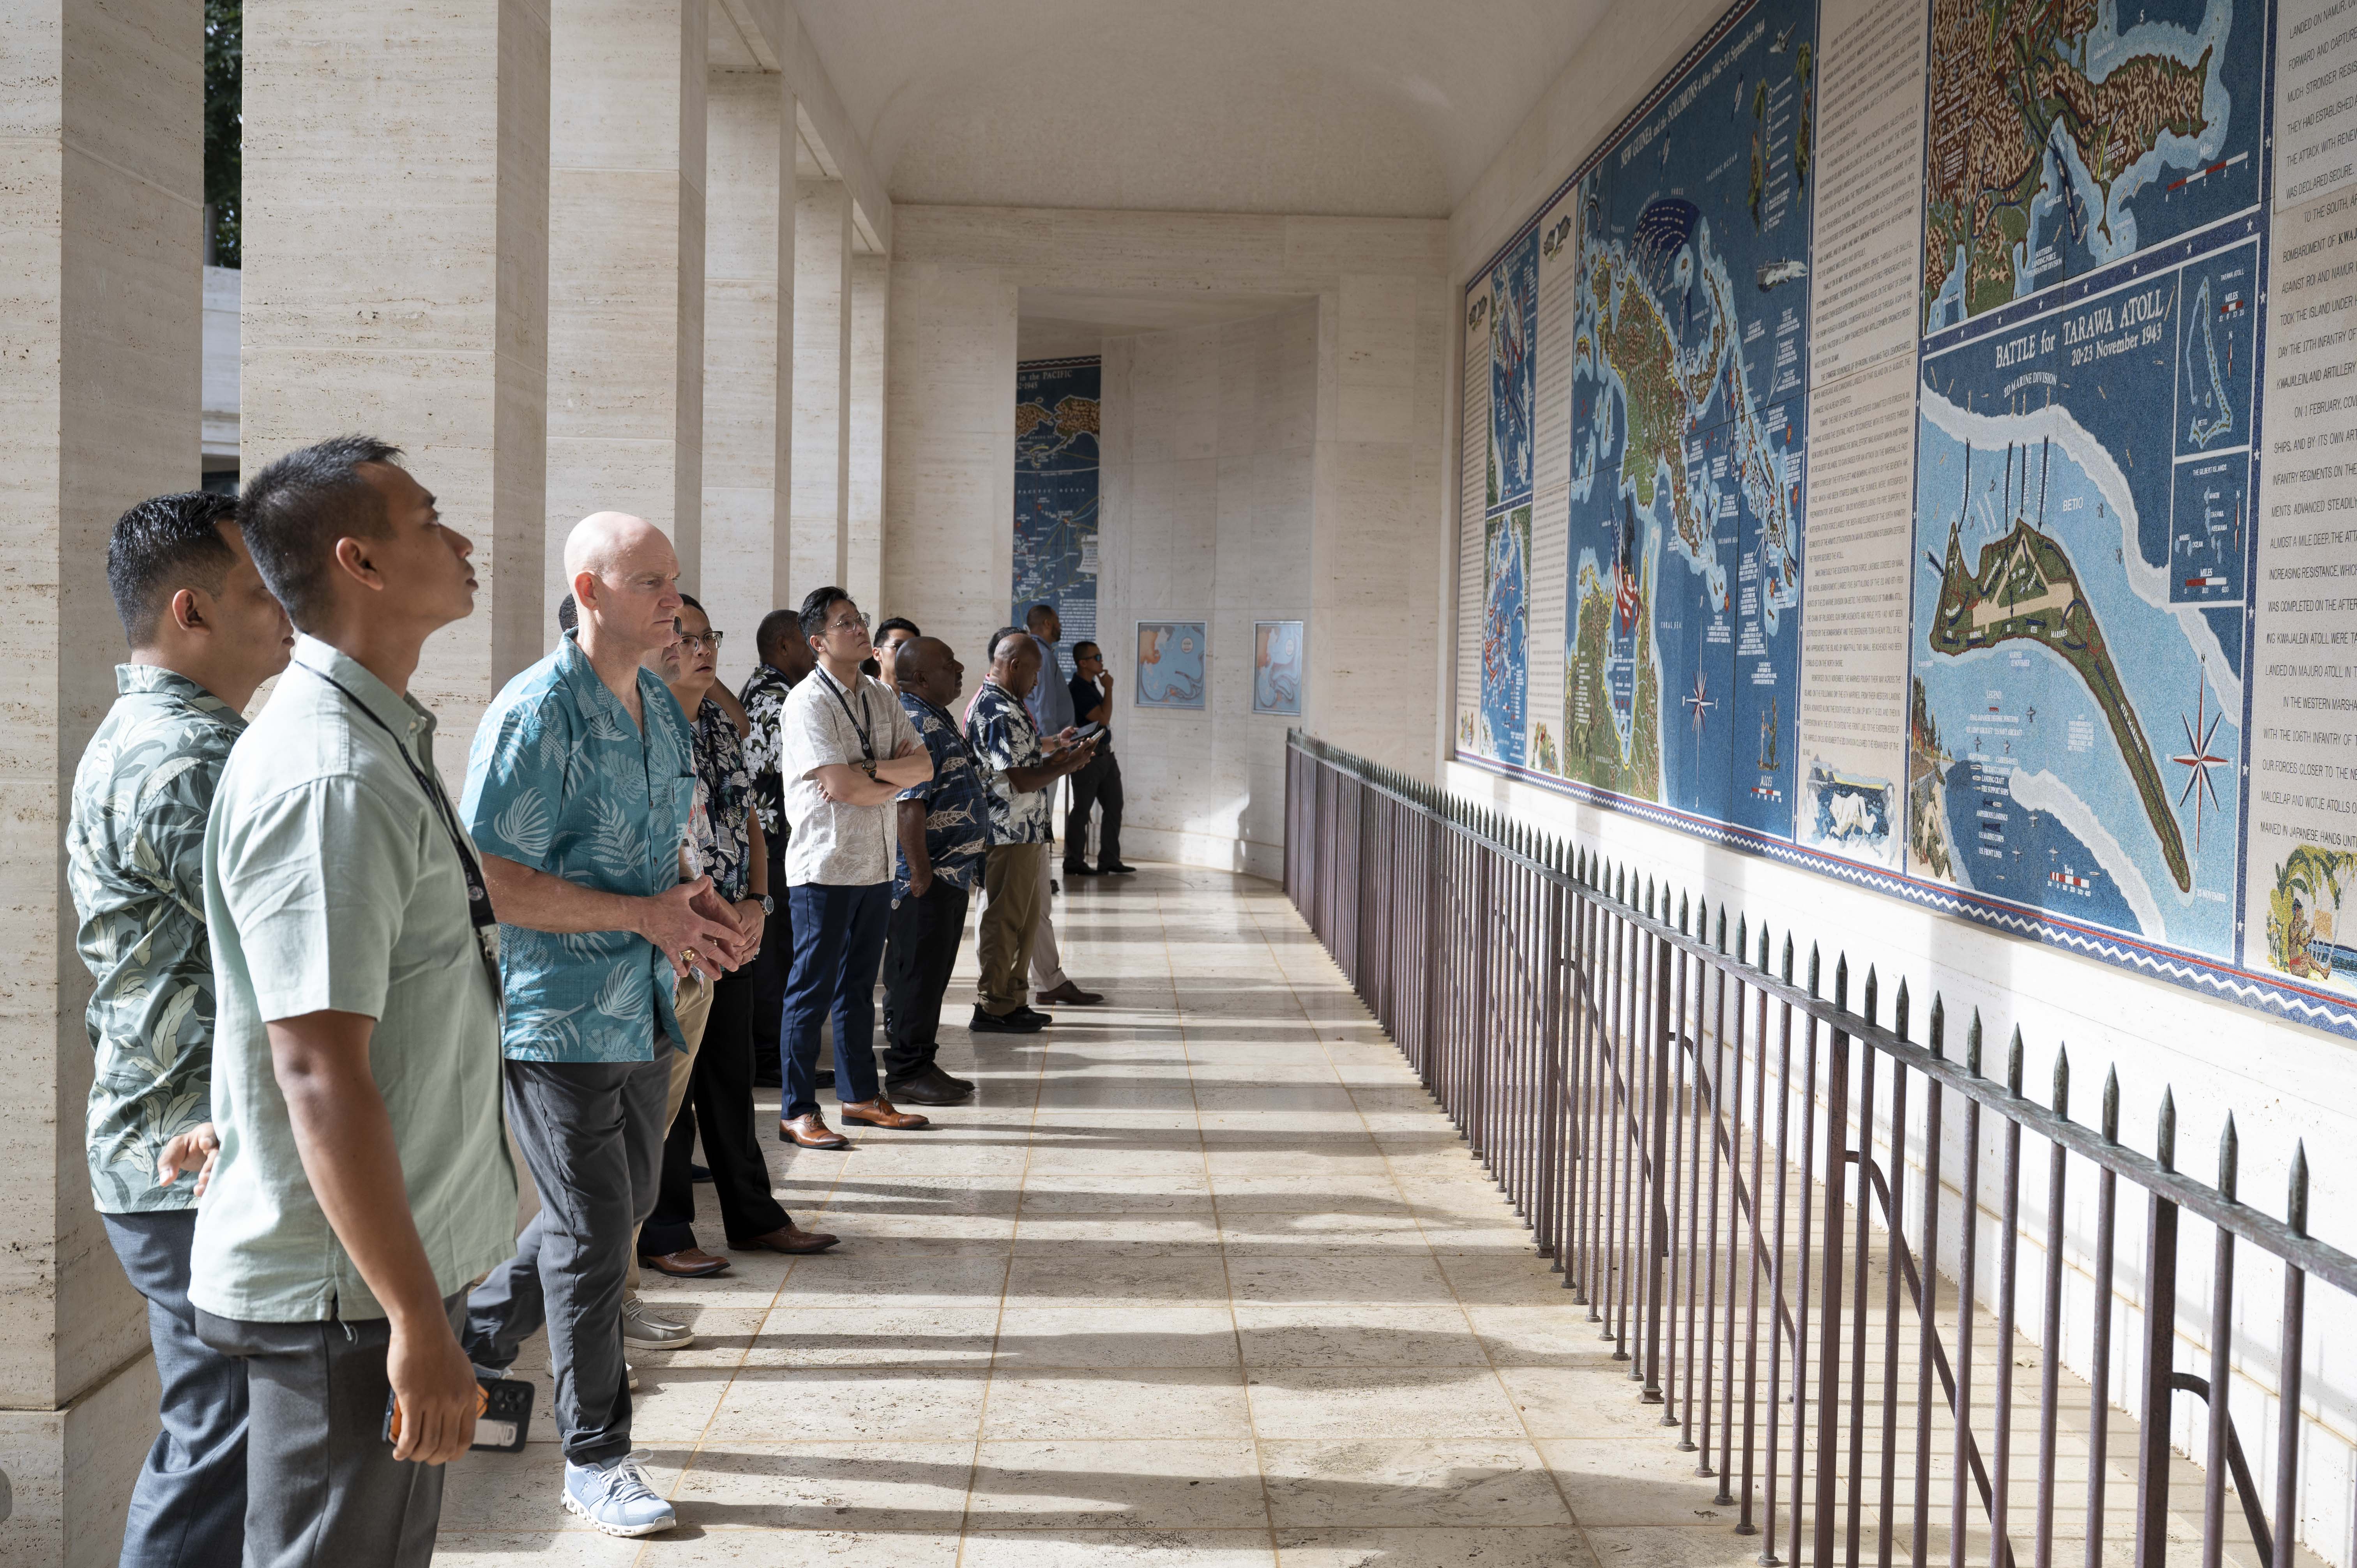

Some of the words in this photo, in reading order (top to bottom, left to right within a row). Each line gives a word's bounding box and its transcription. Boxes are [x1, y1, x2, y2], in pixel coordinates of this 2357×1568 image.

[2290, 18, 2312, 39] LANDED
[2314, 13, 2322, 26] ON
[2323, 0, 2346, 20] NAMUR.
[2289, 49, 2315, 71] FORWARD
[2317, 42, 2329, 58] AND
[2288, 86, 2304, 103] MUCH
[2306, 70, 2336, 94] STRONGER
[1621, 145, 1632, 168] NEW
[1633, 125, 1652, 156] GUINEA
[1668, 79, 1698, 122] SOLOMONS
[1730, 31, 1753, 62] September
[2200, 143, 2213, 157] Miles
[2287, 153, 2297, 167] THE
[2299, 144, 2319, 162] ATTACK
[2321, 137, 2336, 153] WITH
[2224, 170, 2227, 178] 3
[2283, 238, 2325, 262] BOMBARDMENT
[2328, 235, 2336, 247] OF
[2221, 273, 2233, 281] TARAWA
[2234, 268, 2244, 277] ATOLL
[2225, 291, 2238, 302] MILES
[1996, 334, 2035, 368] BATTLE
[2041, 330, 2055, 354] for
[2063, 307, 2114, 345] TARAWA
[2120, 289, 2163, 328] ATOLL
[2229, 331, 2232, 339] N
[2072, 345, 2093, 366] 20-23
[2096, 332, 2138, 359] November
[2142, 322, 2162, 345] 1943
[2279, 346, 2288, 358] DAY
[2290, 342, 2301, 355] THE
[2303, 339, 2316, 352] 17TH
[2318, 331, 2346, 347] INFANTRY
[2348, 328, 2357, 341] OF
[1043, 370, 1072, 379] PACIFIC
[2309, 370, 2321, 382] AND
[2323, 362, 2356, 380] ARTILLERY
[2004, 381, 2010, 398] 2D
[2011, 374, 2032, 391] MARINE
[2033, 372, 2057, 385] DIVISION
[2274, 441, 2291, 454] SHIPS,
[2294, 439, 2305, 451] AND
[2308, 437, 2315, 449] BY
[2318, 435, 2327, 447] ITS
[2330, 432, 2343, 444] OWN
[2213, 464, 2226, 472] ISLANDS
[2236, 490, 2240, 499] N
[2063, 497, 2083, 511] BETIO
[2272, 505, 2291, 517] MENTS
[2294, 501, 2325, 514] ADVANCED
[2200, 568, 2212, 577] MILES
[2269, 568, 2300, 580] INCREASING
[2302, 565, 2339, 578] RESISTANCE,
[2051, 629, 2067, 638] MARINES
[2201, 653, 2205, 663] N
[2266, 665, 2287, 676] LANDED
[2289, 666, 2297, 676] ON
[2299, 666, 2322, 677] MAJURO
[2324, 666, 2343, 677] ATOLL
[2345, 667, 2350, 678] IN
[1987, 690, 2001, 699] LEGEND
[2127, 719, 2143, 754] MARINES
[2263, 729, 2277, 740] WITH
[2280, 729, 2290, 741] THE
[2293, 731, 2311, 742] 106TH
[2313, 732, 2341, 745] INFANTRY
[2344, 734, 2352, 745] OF
[2166, 754, 2171, 763] W
[2230, 758, 2233, 768] E
[1982, 775, 1995, 783] LANDING
[2262, 790, 2290, 804] MALOELAP
[2292, 795, 2303, 806] AND
[2306, 797, 2325, 810] WOTJE
[2327, 800, 2350, 813] ATOLLS
[1983, 832, 1994, 841] MARINE
[2261, 822, 2281, 834] MAINED
[2283, 825, 2288, 835] IN
[2290, 827, 2318, 842] JAPANESE
[2321, 830, 2341, 845] HANDS
[1984, 848, 1993, 856] FRONT
[2195, 860, 2198, 870] S
